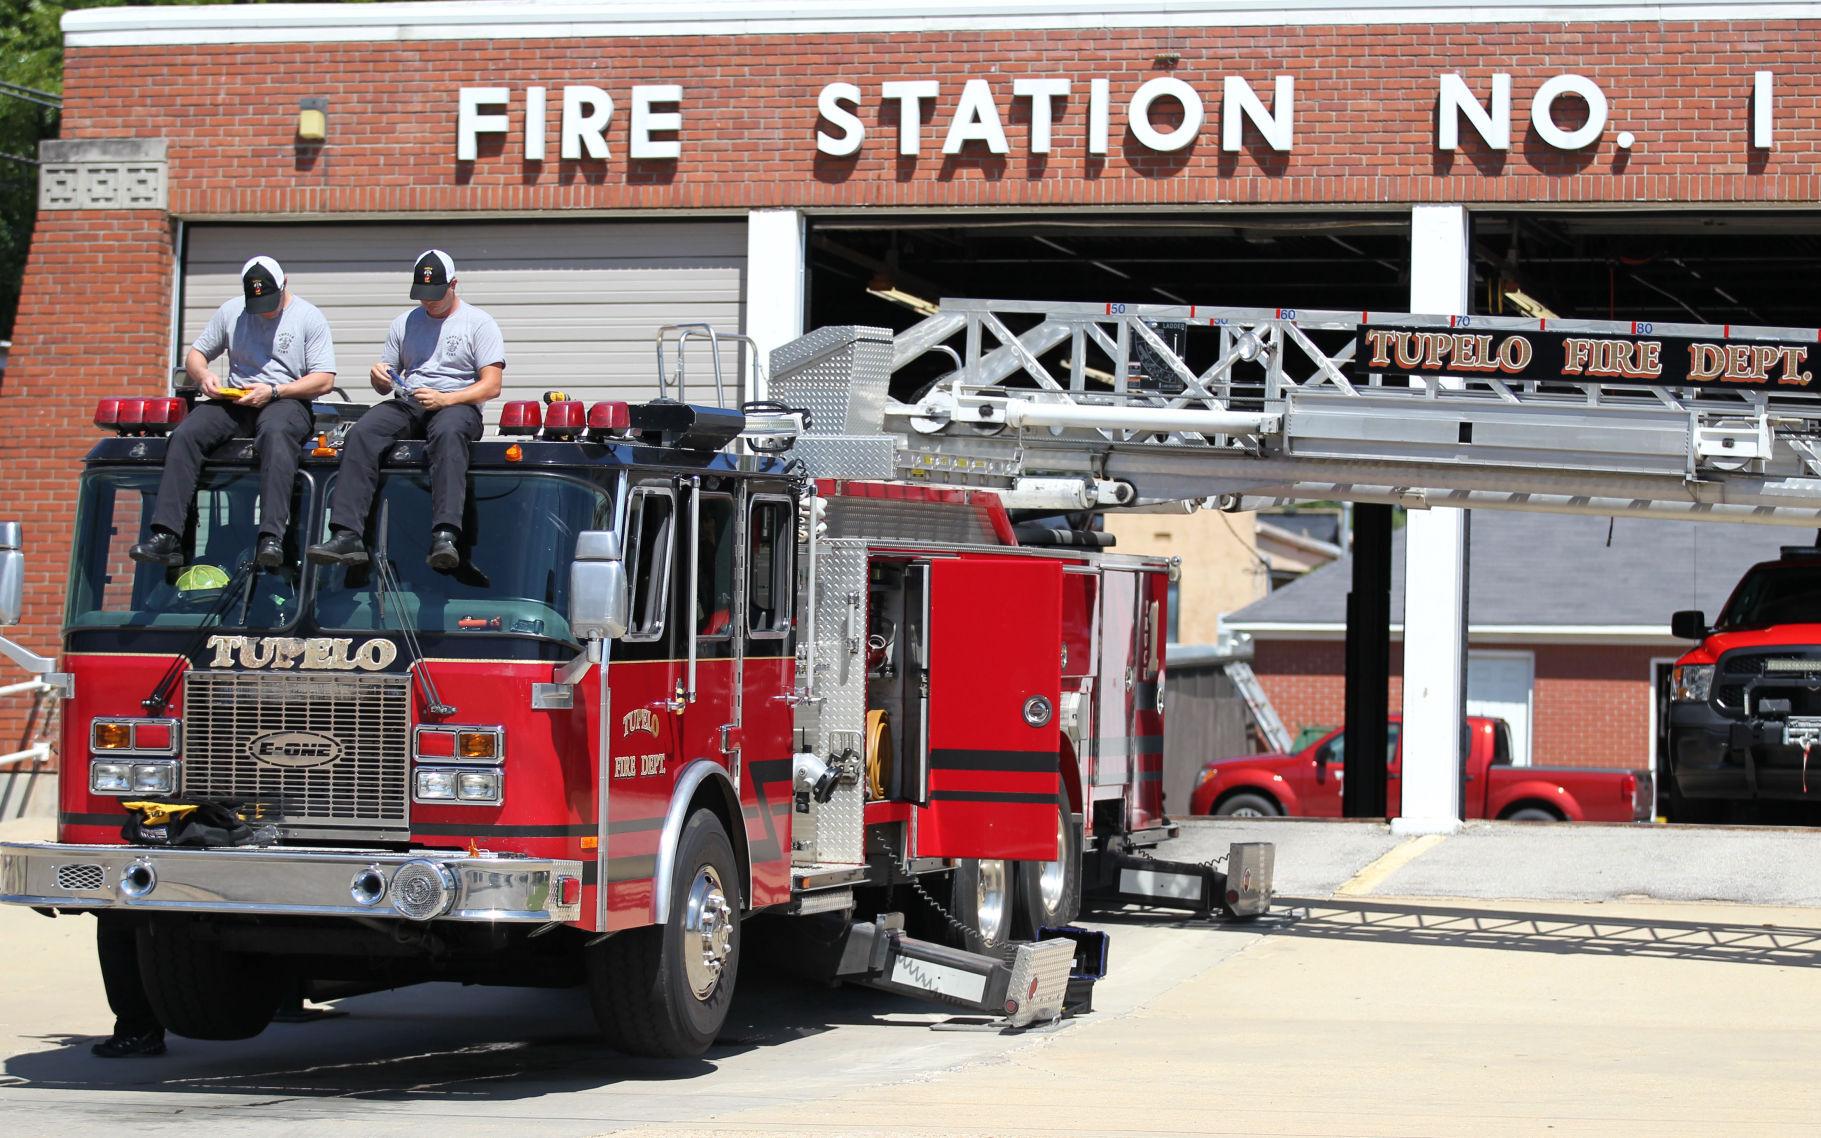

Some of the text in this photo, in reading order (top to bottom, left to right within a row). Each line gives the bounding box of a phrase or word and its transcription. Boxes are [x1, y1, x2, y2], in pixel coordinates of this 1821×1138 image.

[457, 85, 682, 160] FIRE
[816, 75, 1295, 157] STATION
[1439, 73, 1635, 150] NO.
[1111, 304, 1126, 314] 50
[1280, 309, 1296, 320] 60
[1456, 316, 1471, 327] 70
[1636, 323, 1653, 334] 80
[1365, 328, 1813, 386] TUPELO FIRE DEPT.
[206, 634, 397, 671] TUPELO
[623, 708, 659, 738] TUPELO
[258, 742, 332, 757] E-ONE
[614, 756, 636, 778] FIRE
